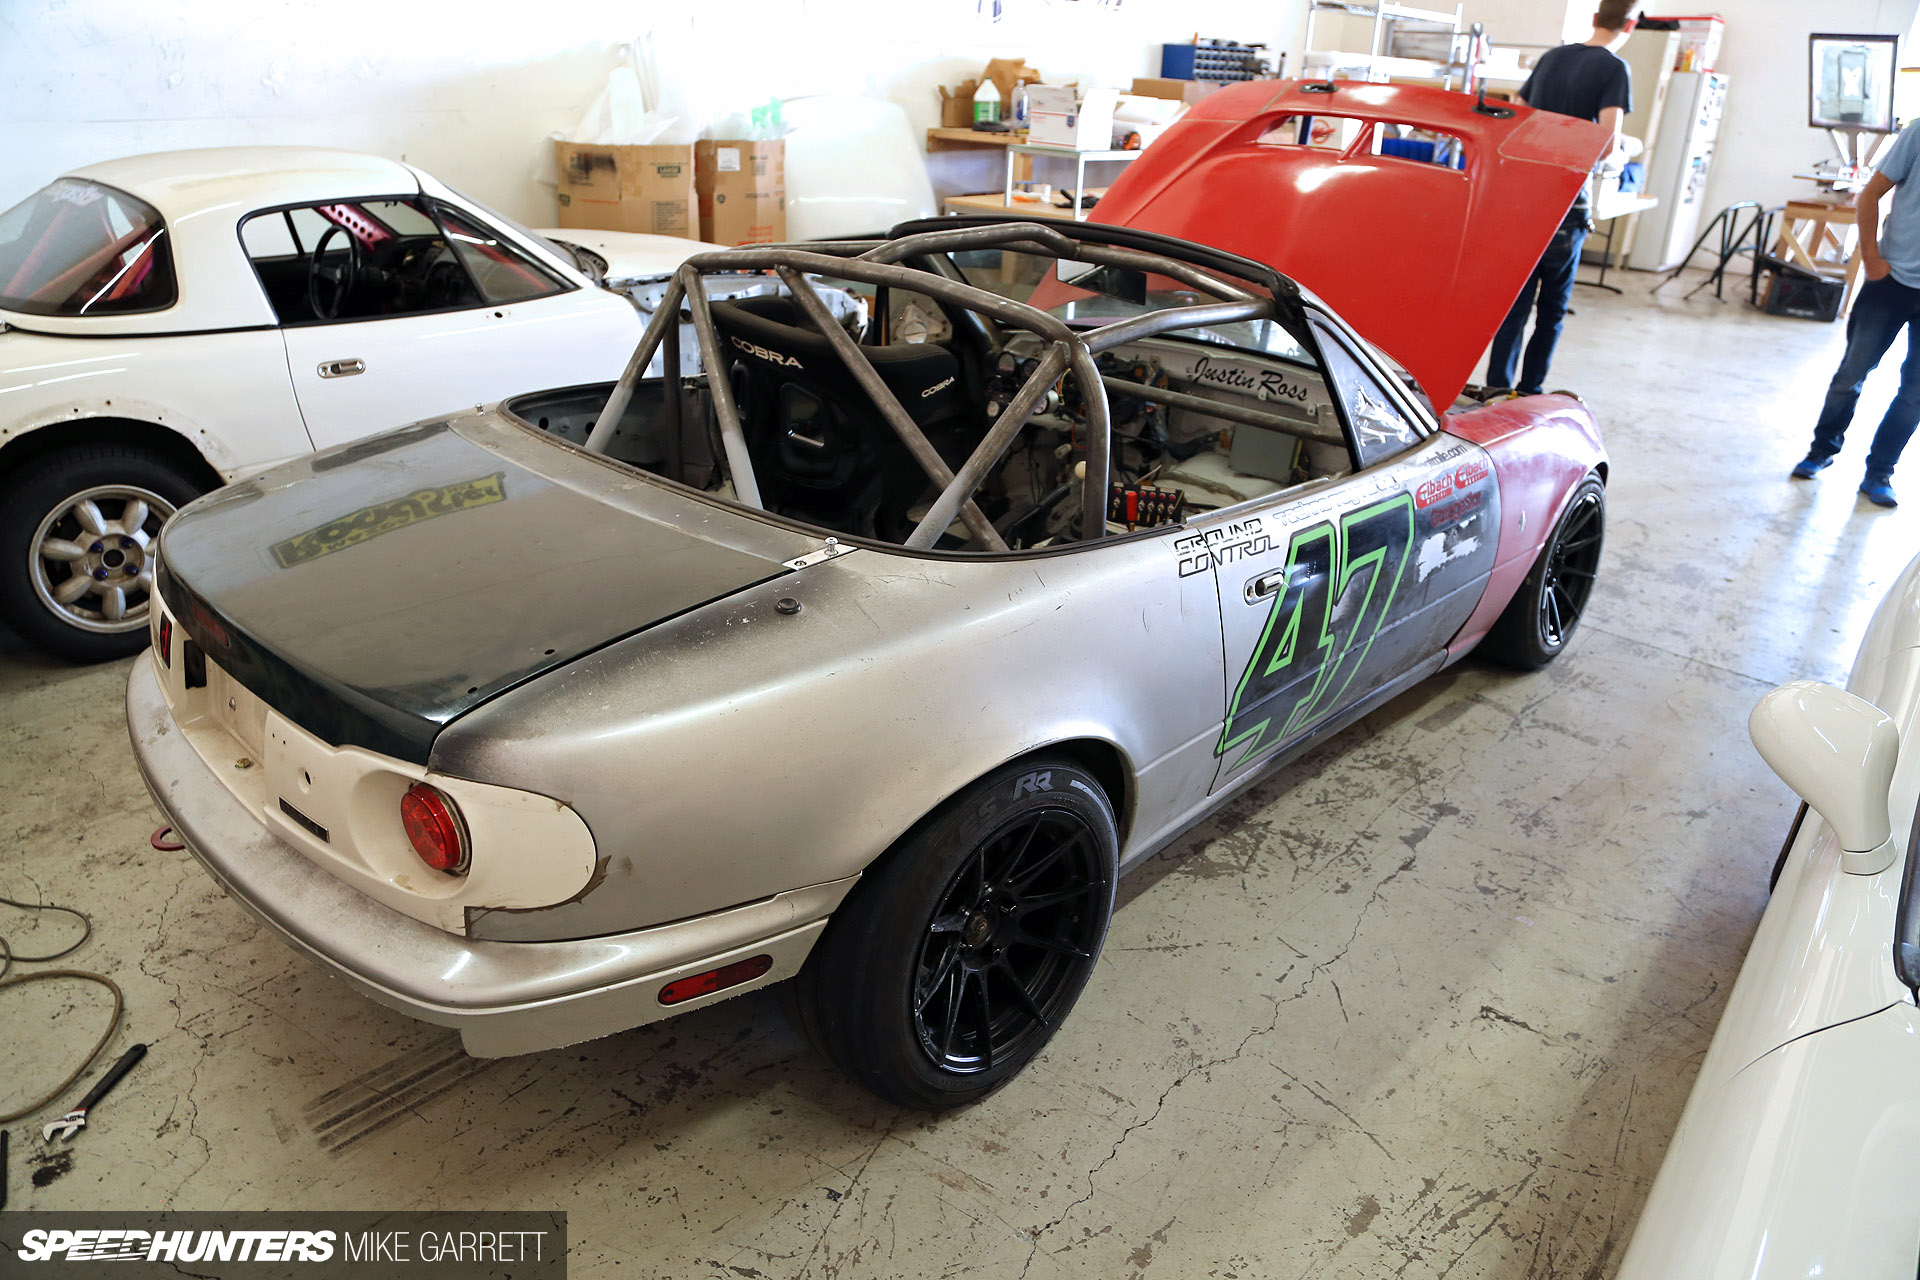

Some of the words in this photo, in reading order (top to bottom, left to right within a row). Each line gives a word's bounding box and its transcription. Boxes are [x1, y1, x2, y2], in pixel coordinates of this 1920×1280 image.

[730, 335, 804, 369] COBRA
[921, 376, 955, 398] COBRA
[1193, 356, 1255, 389] Justin
[1257, 370, 1309, 401] Ross
[1416, 471, 1453, 509] Eibach
[1455, 454, 1489, 490] Eibach
[1178, 535, 1280, 579] CONTROL
[1215, 490, 1416, 775] 47
[1012, 771, 1054, 802] RR
